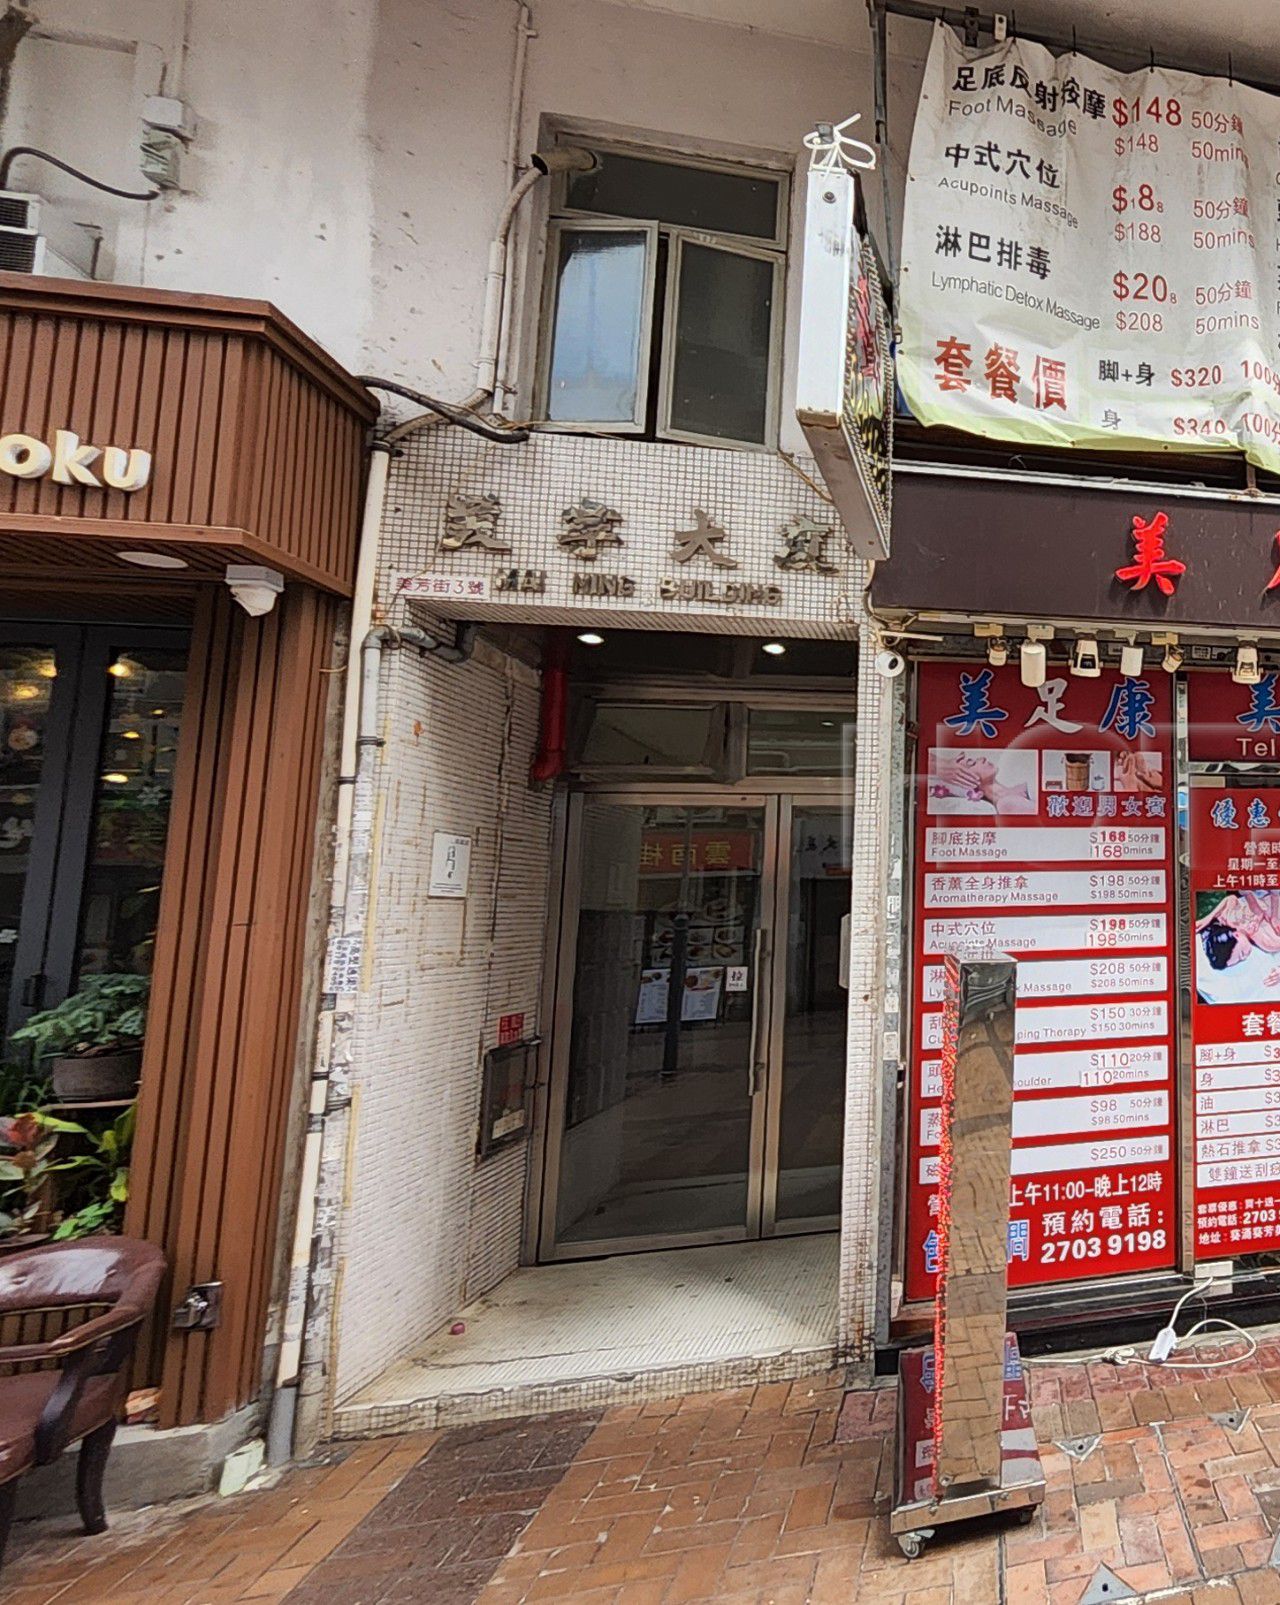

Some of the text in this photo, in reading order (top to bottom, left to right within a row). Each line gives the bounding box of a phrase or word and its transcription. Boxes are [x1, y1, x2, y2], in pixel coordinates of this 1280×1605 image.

[952, 64, 1106, 120] 足底反射按摩
[1112, 96, 1182, 128] $148
[948, 95, 1158, 156] Foot Massage $148
[945, 141, 1060, 189] 中式穴位
[938, 177, 1255, 249] Acupoints Massage $188 50mins
[935, 225, 1052, 279] 淋巴排毒
[1195, 279, 1252, 305] 50分鐘
[932, 271, 1259, 335] Lymphatic Detox Massage $208 50mins
[934, 336, 1067, 411] 套餐價
[1170, 365, 1221, 388] $320
[1102, 409, 1121, 429] 身
[944, 669, 1156, 740] 美足康
[1047, 796, 1166, 817] 歡迎男女賓
[931, 846, 957, 857] Foot
[958, 846, 1008, 858] Massage
[1090, 874, 1125, 887] $198
[931, 889, 1154, 905] Aromatherapy Massage $198 50mins
[931, 921, 996, 937] 中式穴位
[990, 937, 1036, 950] Massage
[1118, 932, 1154, 942] 50mins
[1090, 962, 1126, 976] $208
[1023, 976, 1155, 993] Massage $208 50mins
[1090, 1007, 1126, 1020] $150
[1091, 1022, 1116, 1032] $150
[1118, 1021, 1155, 1031] 30mins
[1090, 1053, 1128, 1068] $110
[1112, 1069, 1149, 1080] 20mins
[1091, 1099, 1117, 1113] $98
[1091, 1113, 1149, 1126] $98 50mins
[1201, 1119, 1229, 1134] 淋巴
[1091, 1148, 1126, 1161] $250
[1040, 1238, 1101, 1263] 2703
[1107, 1229, 1166, 1255] 9198
